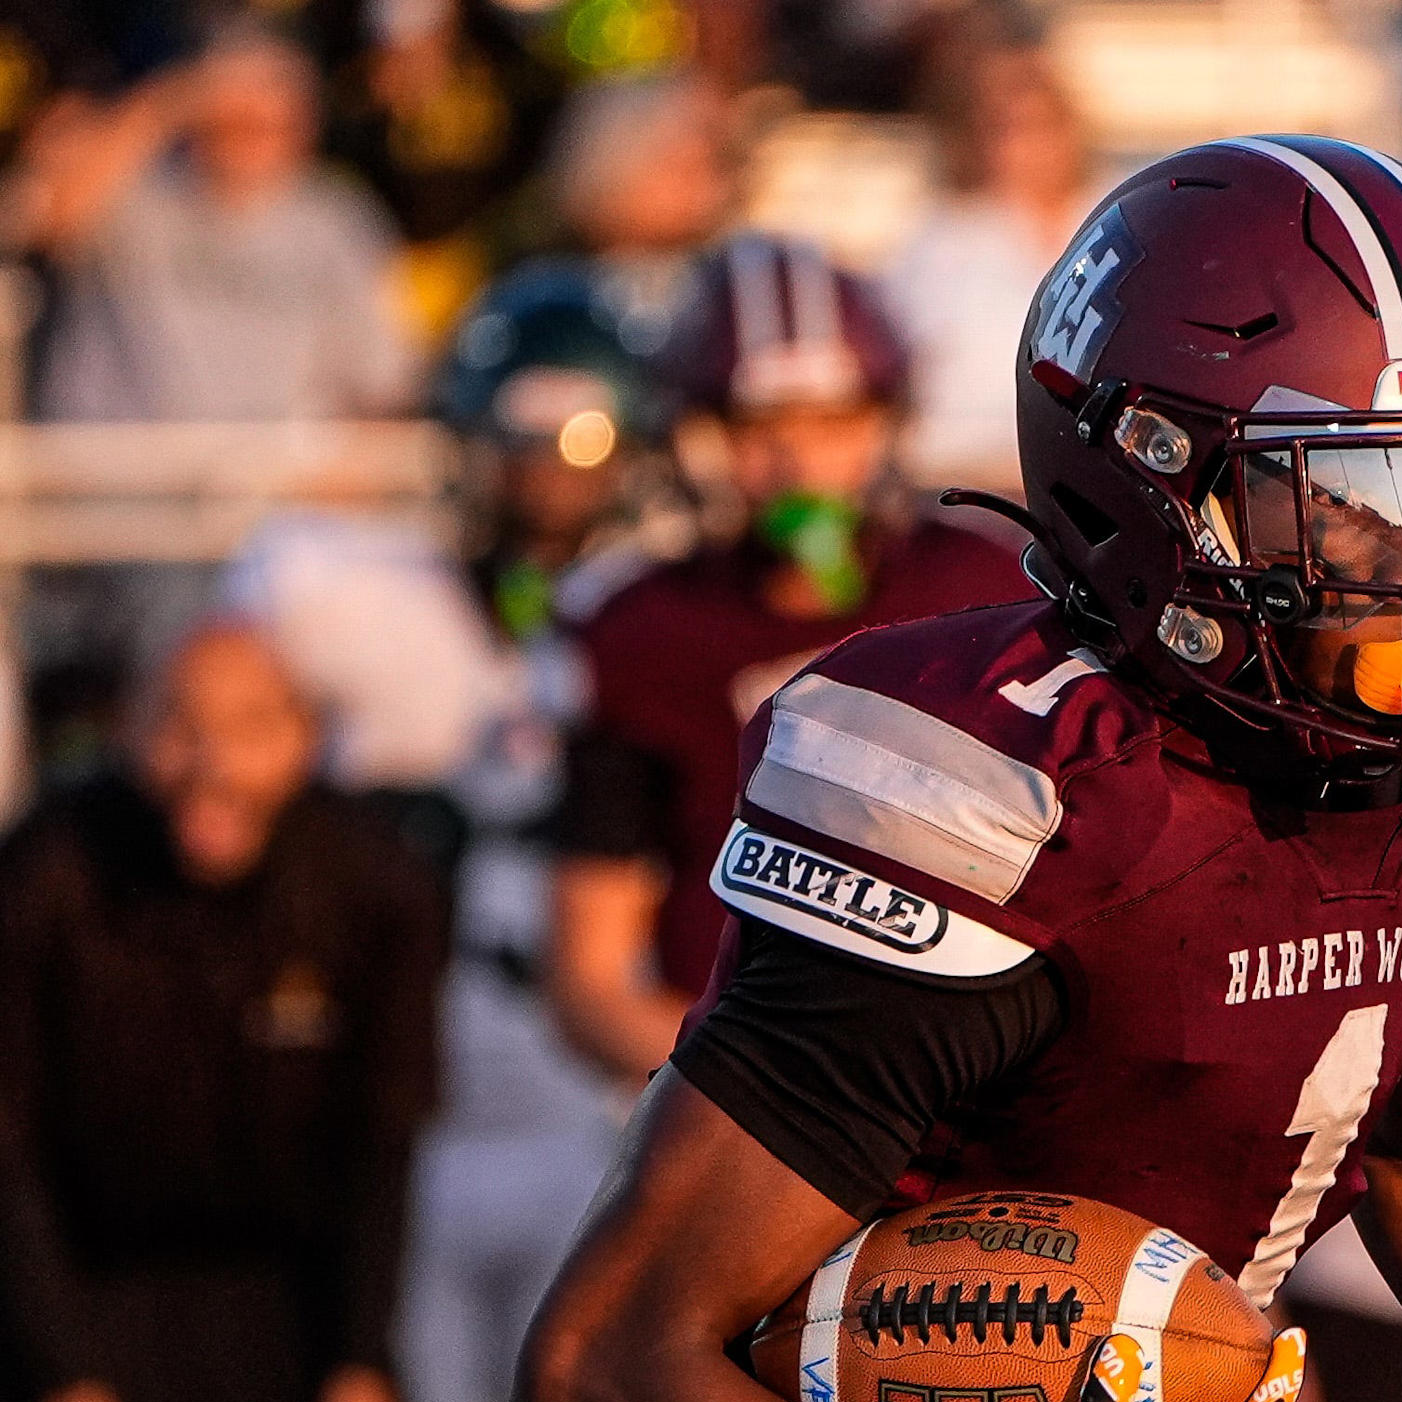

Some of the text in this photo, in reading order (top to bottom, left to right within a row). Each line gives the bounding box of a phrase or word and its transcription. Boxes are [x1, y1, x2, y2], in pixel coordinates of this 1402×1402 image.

[732, 836, 927, 939] BATTLE
[1225, 929, 1364, 1005] HARPER
[1237, 1003, 1388, 1310] 1
[903, 1220, 1079, 1264] Wilson
